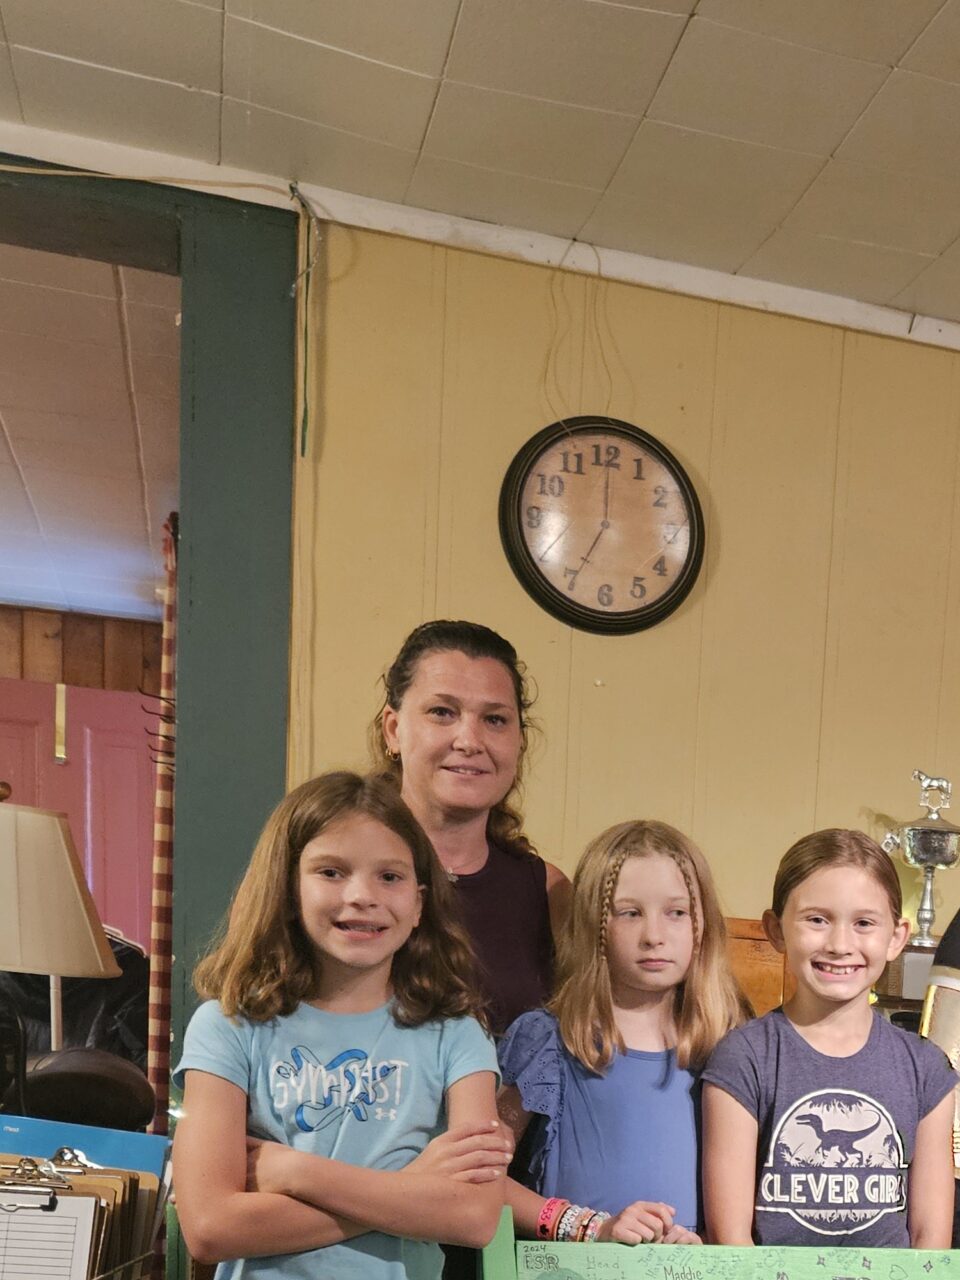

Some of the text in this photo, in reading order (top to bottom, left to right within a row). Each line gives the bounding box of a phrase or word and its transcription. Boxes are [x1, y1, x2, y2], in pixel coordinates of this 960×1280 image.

[560, 452, 586, 475] 11
[591, 444, 621, 470] 12
[633, 458, 645, 480] 1
[537, 474, 565, 497] 10
[653, 485, 668, 508] 2
[527, 506, 542, 529] 9
[652, 556, 667, 577] 4
[564, 568, 578, 591] 7
[630, 577, 647, 599] 5
[597, 584, 614, 607] 6
[761, 1172, 860, 1204] CLEVER
[523, 1245, 546, 1253] 2024
